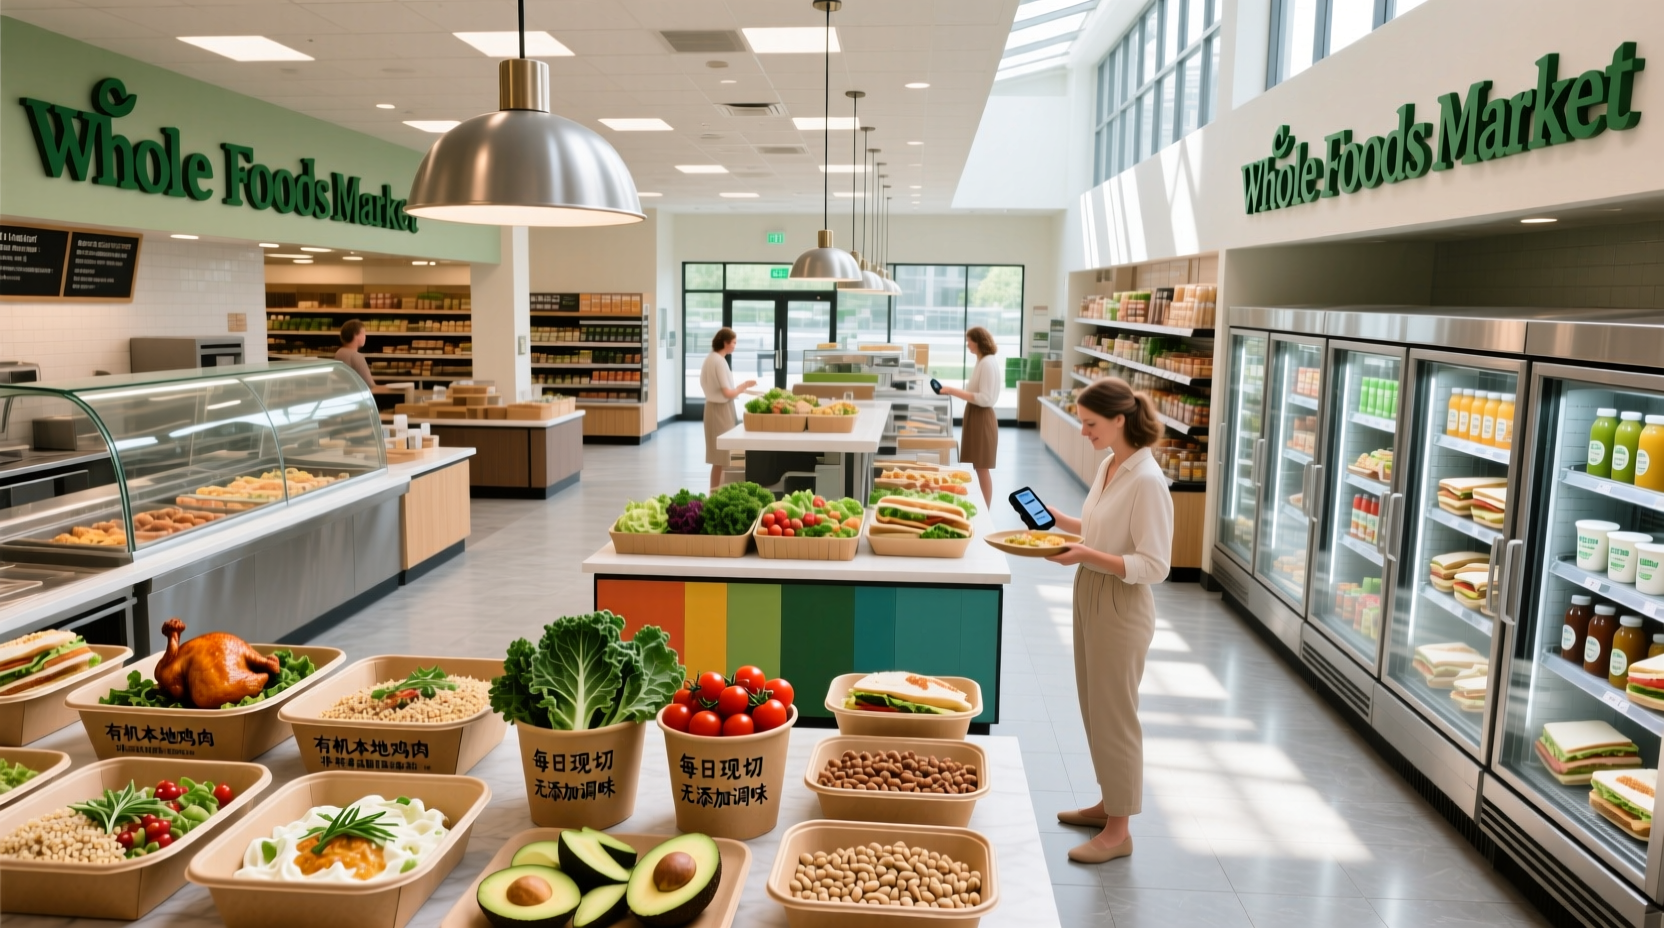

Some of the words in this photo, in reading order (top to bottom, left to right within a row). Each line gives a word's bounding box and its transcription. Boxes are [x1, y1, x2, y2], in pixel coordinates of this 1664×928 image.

[1241, 142, 1324, 214] Whole
[1321, 103, 1433, 198] Foods
[1432, 42, 1646, 172] Market
[18, 97, 214, 201] Whole
[220, 143, 331, 219] Foods
[105, 722, 215, 747] 有机本地鸡肉
[313, 734, 429, 759] 有机本地鸡肉
[532, 748, 614, 774] 每日现切
[679, 753, 763, 780] 每日现切
[534, 776, 616, 802] 无添加调味
[681, 782, 768, 808] 无添加调味
